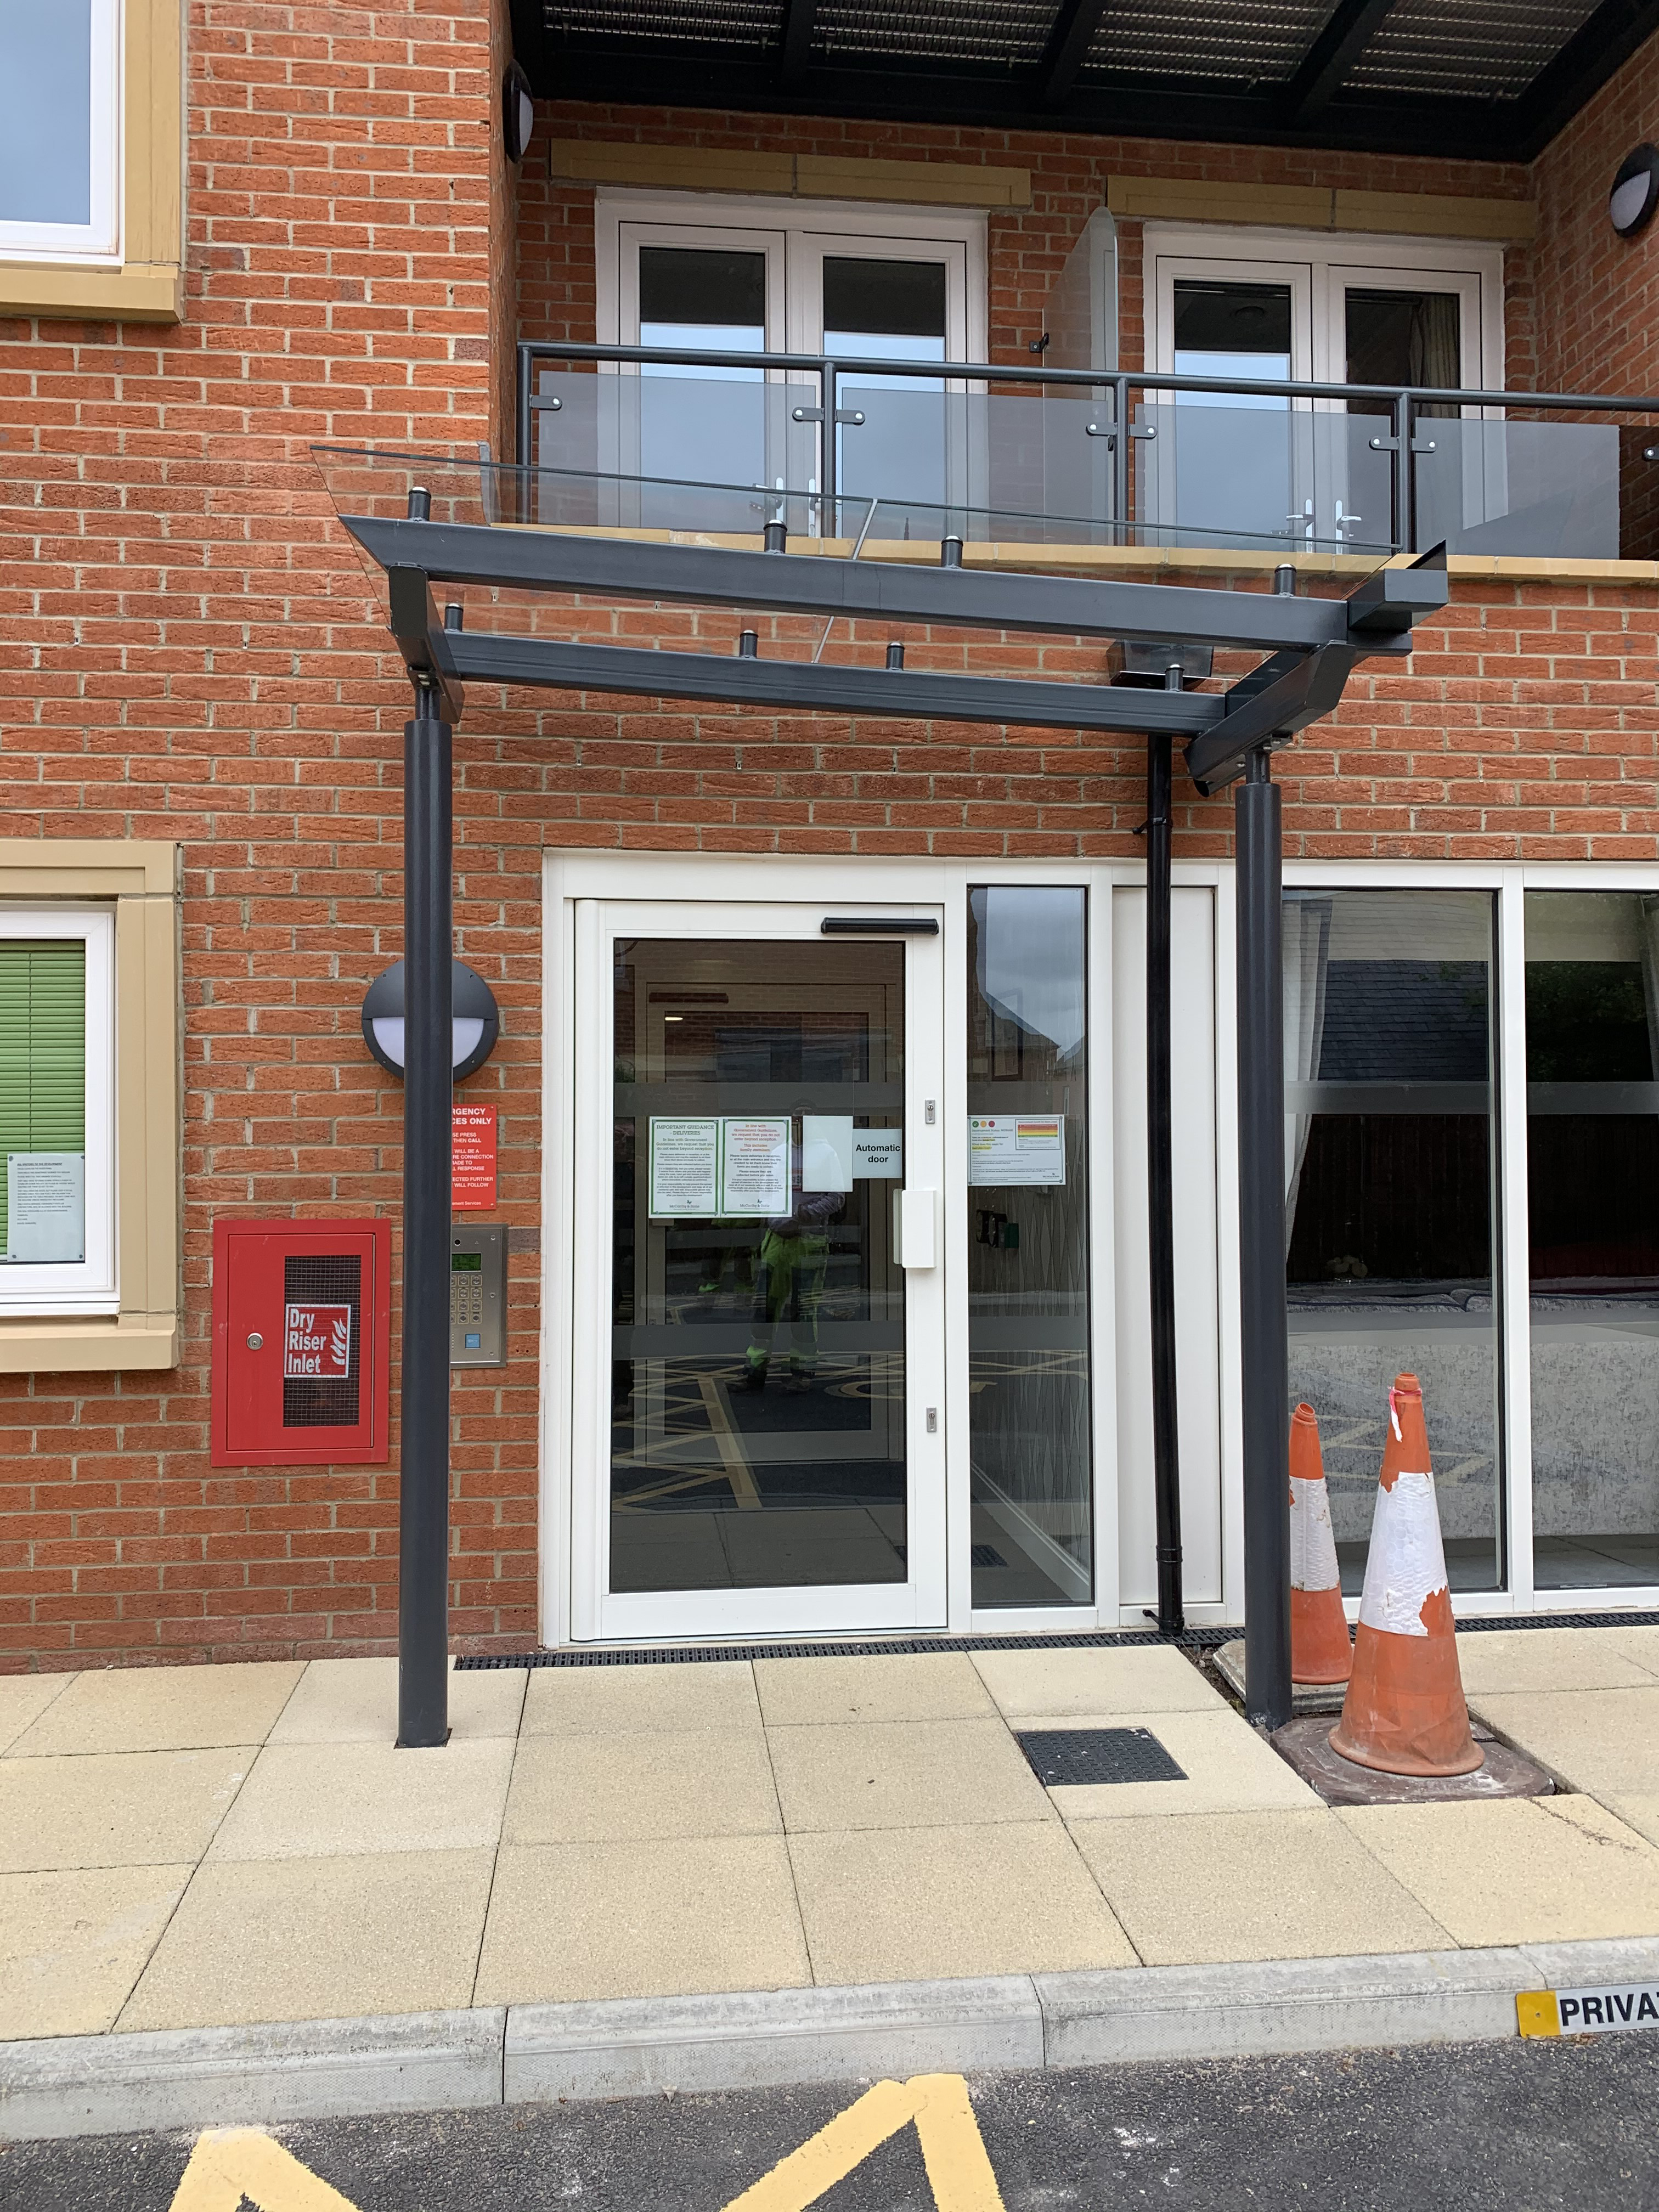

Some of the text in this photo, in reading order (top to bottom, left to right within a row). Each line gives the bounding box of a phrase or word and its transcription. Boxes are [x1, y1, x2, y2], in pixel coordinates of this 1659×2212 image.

[290, 1308, 315, 1333] Dry
[289, 1331, 326, 1351] Riser
[288, 1353, 321, 1373] Inlet
[1560, 1991, 1659, 2027] PRIVA
